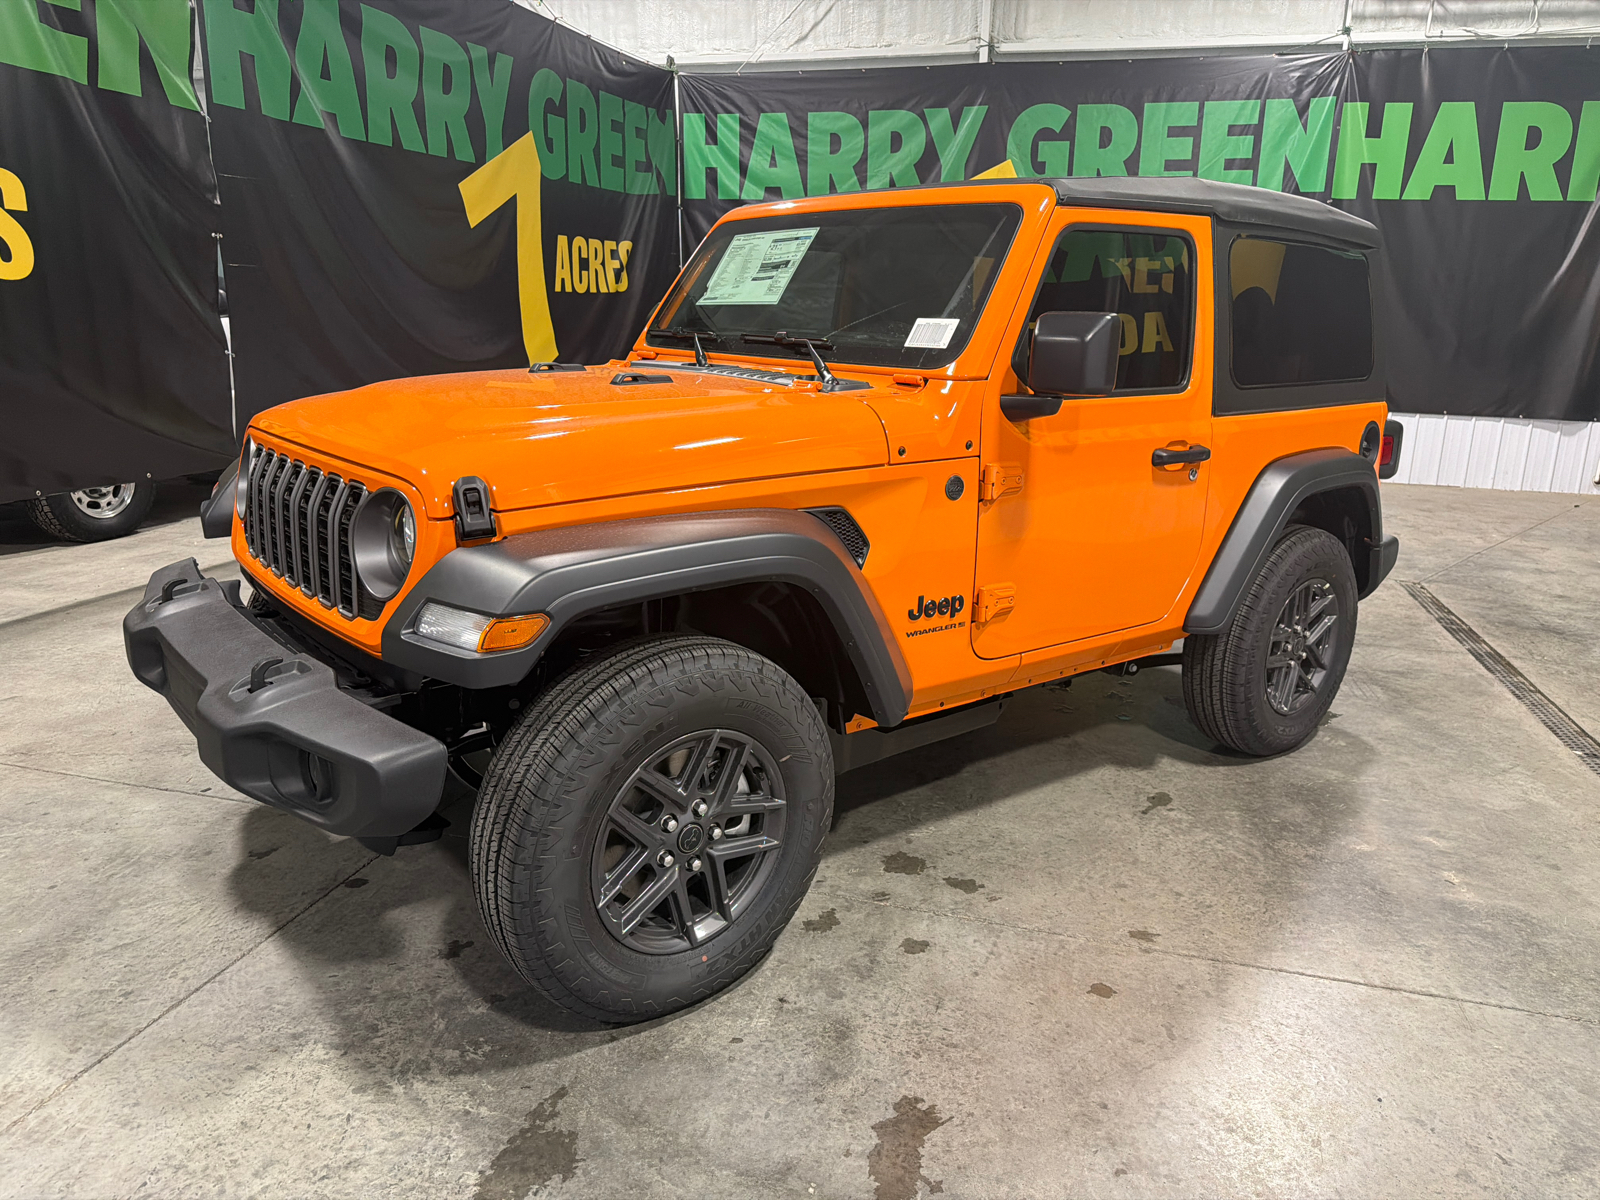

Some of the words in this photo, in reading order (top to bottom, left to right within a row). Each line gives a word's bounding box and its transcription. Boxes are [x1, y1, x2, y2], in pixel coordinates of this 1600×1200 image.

[203, 0, 514, 164] HARRY
[527, 67, 676, 196] GREEN
[682, 105, 989, 200] HARRY
[1006, 96, 1338, 194] GREEN
[555, 234, 633, 295] ACRES
[906, 623, 957, 638] WRANGLER
[909, 595, 964, 620] Jeep
